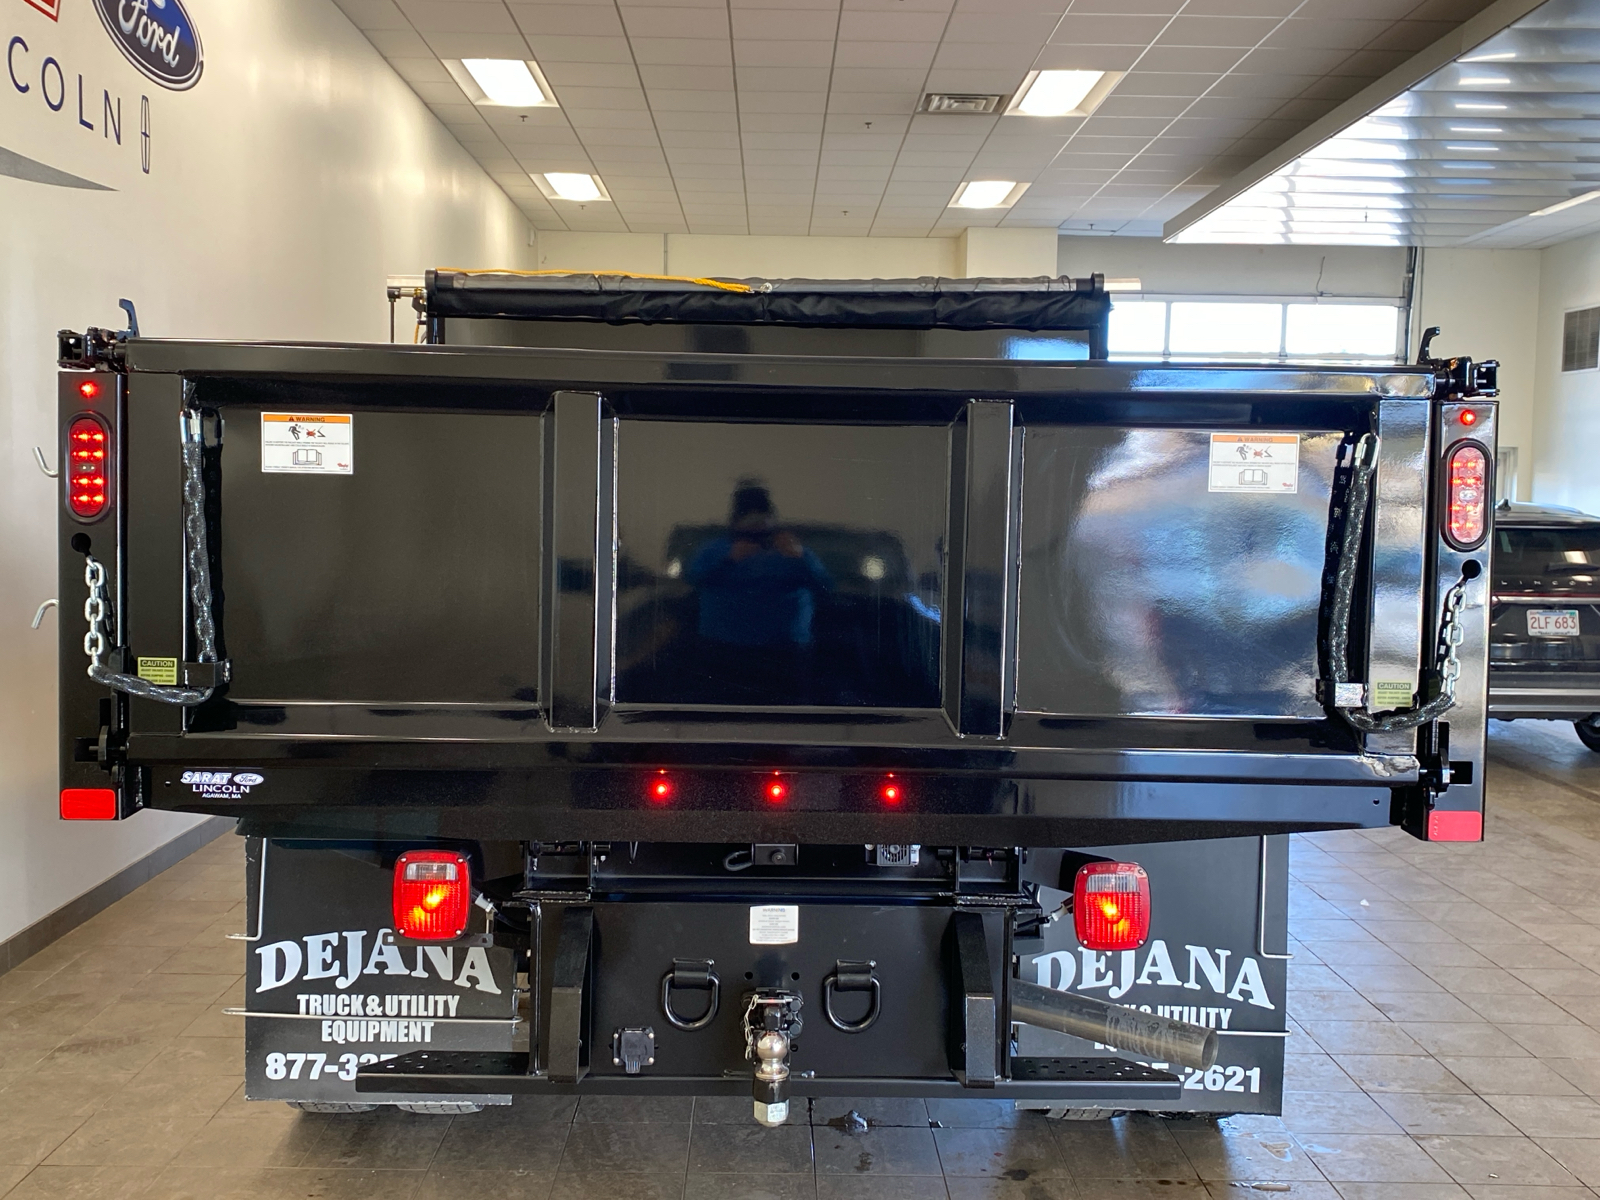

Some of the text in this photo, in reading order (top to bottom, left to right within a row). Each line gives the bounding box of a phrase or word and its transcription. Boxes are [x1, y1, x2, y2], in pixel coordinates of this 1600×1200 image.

[118, 0, 181, 68] Ford
[1530, 616, 1577, 630] 2LF 683
[180, 771, 232, 785] SARAT
[192, 784, 250, 793] LINCOLN
[255, 928, 502, 994] DEJANA
[1032, 940, 1275, 1010] DEJANA
[321, 1020, 435, 1044] EQUIPMENT
[265, 1052, 399, 1081] 877-3
